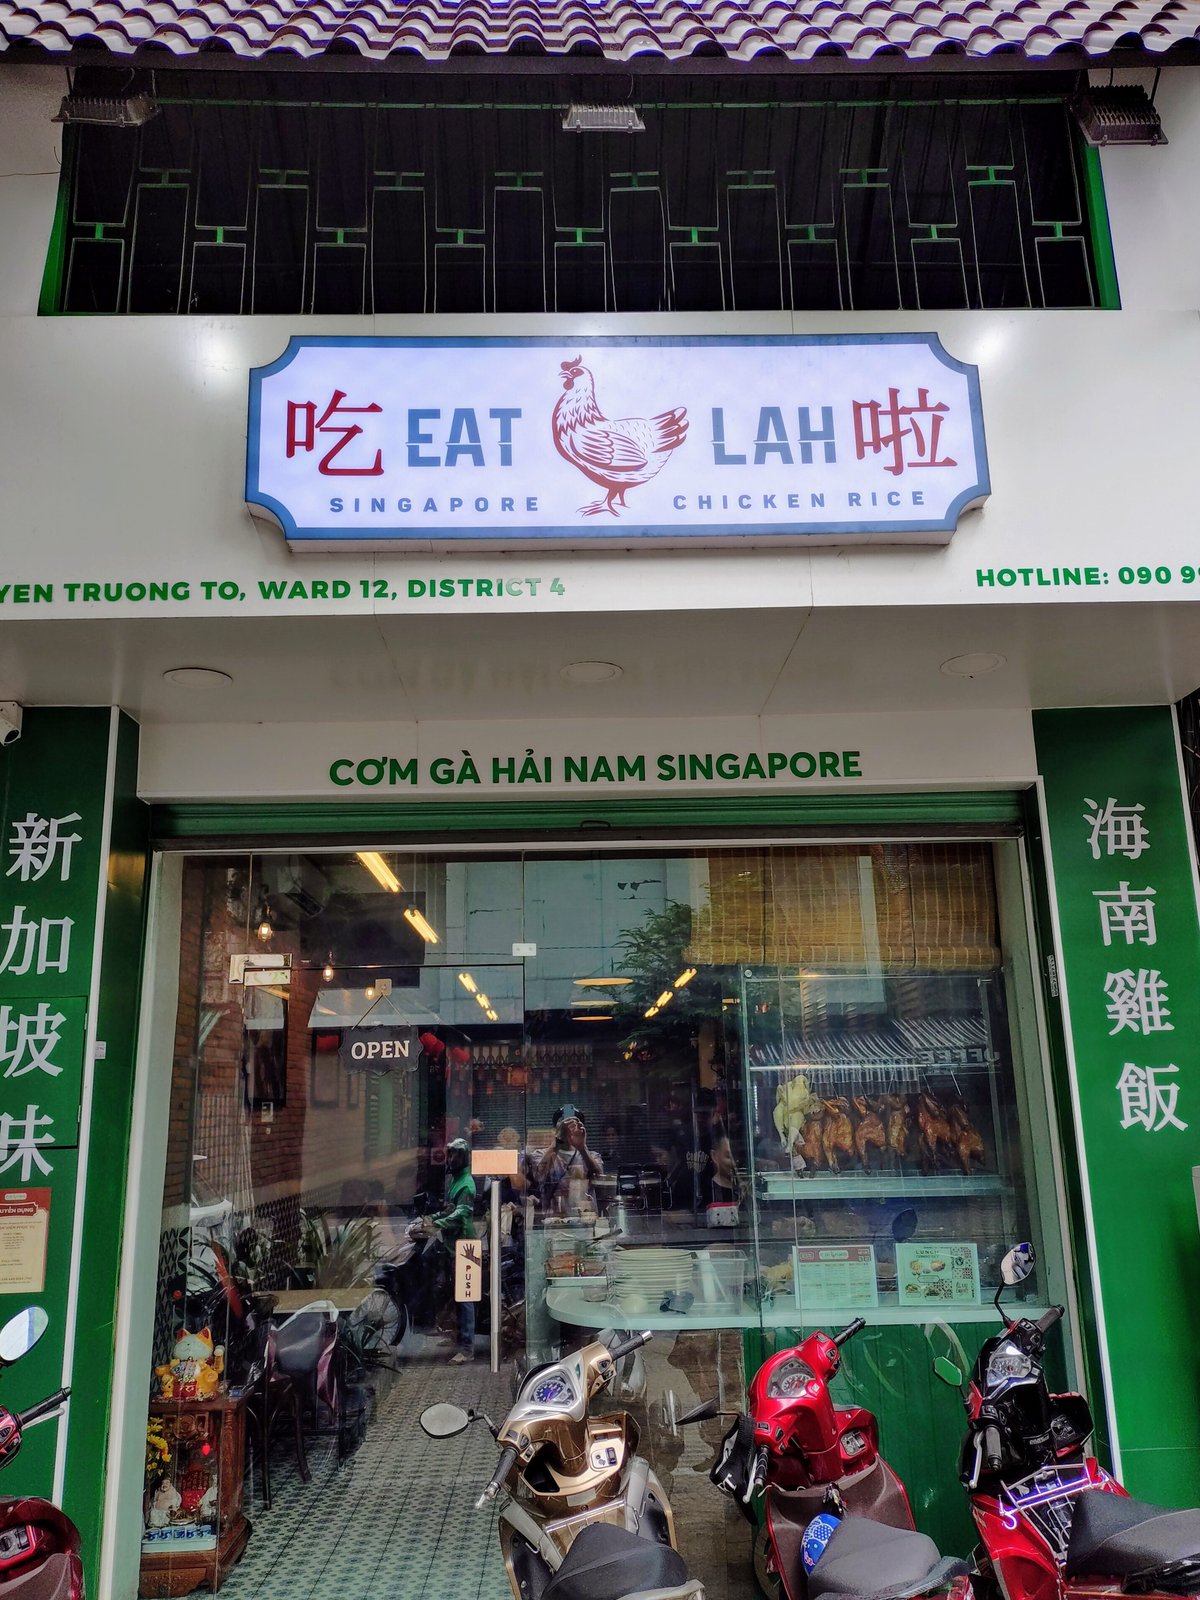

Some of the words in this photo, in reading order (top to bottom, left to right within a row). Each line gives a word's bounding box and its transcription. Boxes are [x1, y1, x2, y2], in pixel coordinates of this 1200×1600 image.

[286, 389, 384, 476] 吃
[406, 408, 522, 467] EAT
[711, 406, 837, 465] LAH
[852, 387, 957, 476] 啦
[330, 497, 538, 512] SINGAPORE
[673, 493, 825, 510] CHICKEN
[848, 491, 924, 506] RICE
[64, 581, 190, 602] TRUONG
[201, 580, 246, 602] TO,
[258, 580, 351, 600] WARD
[359, 579, 397, 601] 12,
[408, 578, 541, 598] DISTRICT
[550, 578, 566, 596] 4
[976, 567, 1109, 587] HOTLINE:
[1118, 566, 1172, 585] 090
[1180, 565, 1200, 584] 9
[329, 756, 418, 786] CƠM
[429, 750, 481, 785] GÀ
[492, 748, 552, 784] HẢI
[564, 755, 646, 783] NAM
[656, 750, 862, 781] SINGAPORE
[1083, 798, 1189, 1132] 海南雞飯
[0, 812, 82, 1182] 新加坡味
[351, 1040, 410, 1060] OPEN
